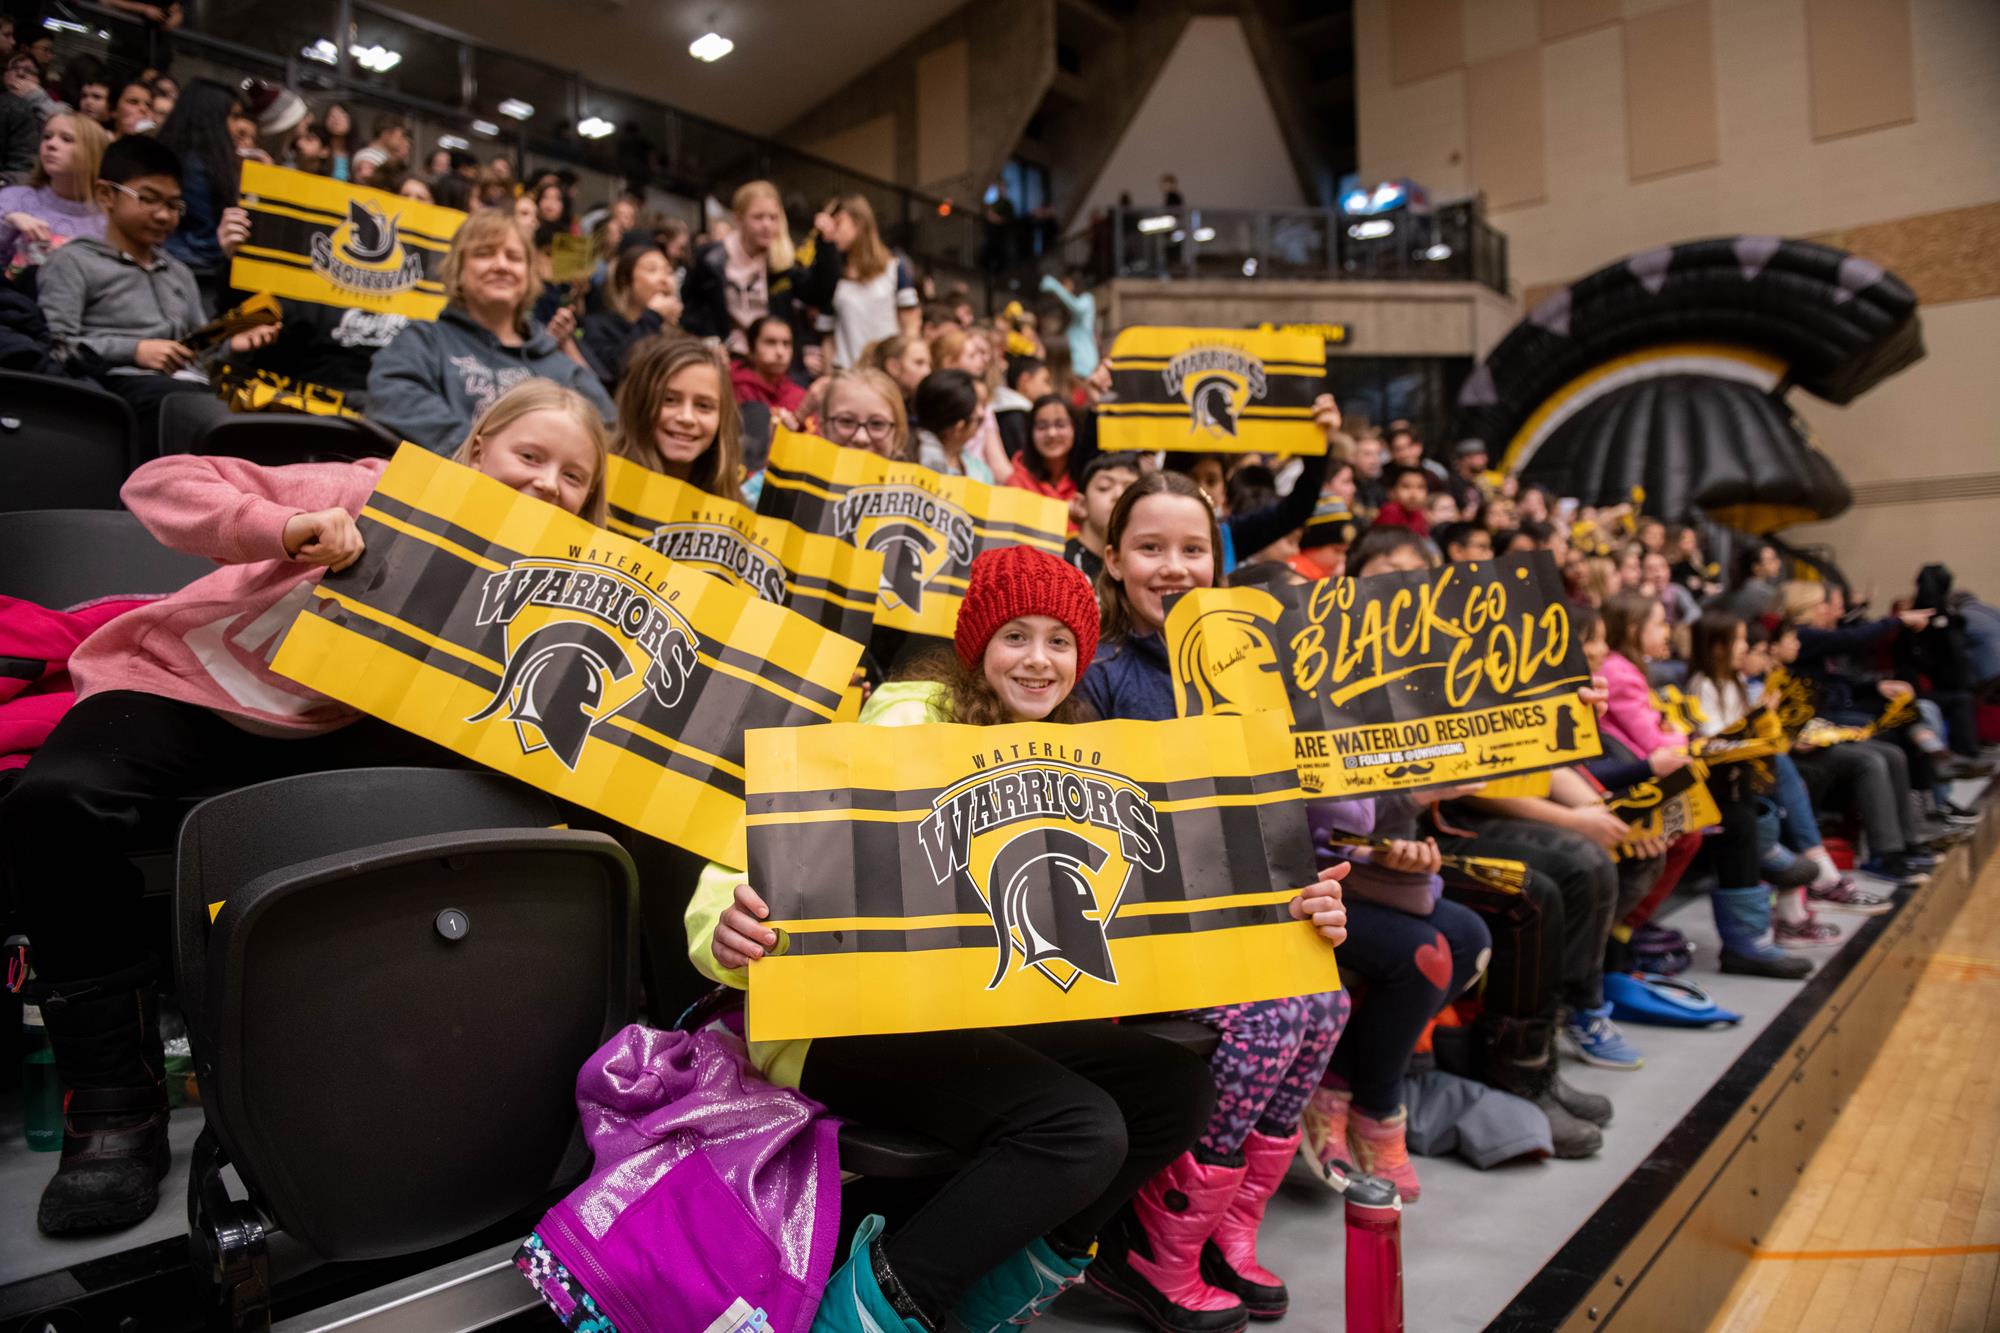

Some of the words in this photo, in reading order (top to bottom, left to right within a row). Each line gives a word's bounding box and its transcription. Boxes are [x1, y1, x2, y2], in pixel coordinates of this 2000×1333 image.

[691, 510, 769, 547] WATERLOO
[833, 492, 975, 567] WARRIORS
[568, 544, 681, 602] WATERLOO
[1307, 576, 1356, 624] GO
[1289, 566, 1471, 692] BLACK
[1463, 581, 1507, 634] GO
[475, 567, 699, 709] WARRIORS
[1444, 602, 1570, 708] GOLD
[972, 741, 1102, 770] WATERLOO
[1294, 735, 1330, 759] ARE
[1332, 722, 1430, 755] WATERLOO
[1435, 704, 1547, 742] RESIDENCES
[1358, 752, 1391, 767] FOLLOW
[917, 769, 1166, 886] WARRIORS
[449, 917, 457, 931] 1
